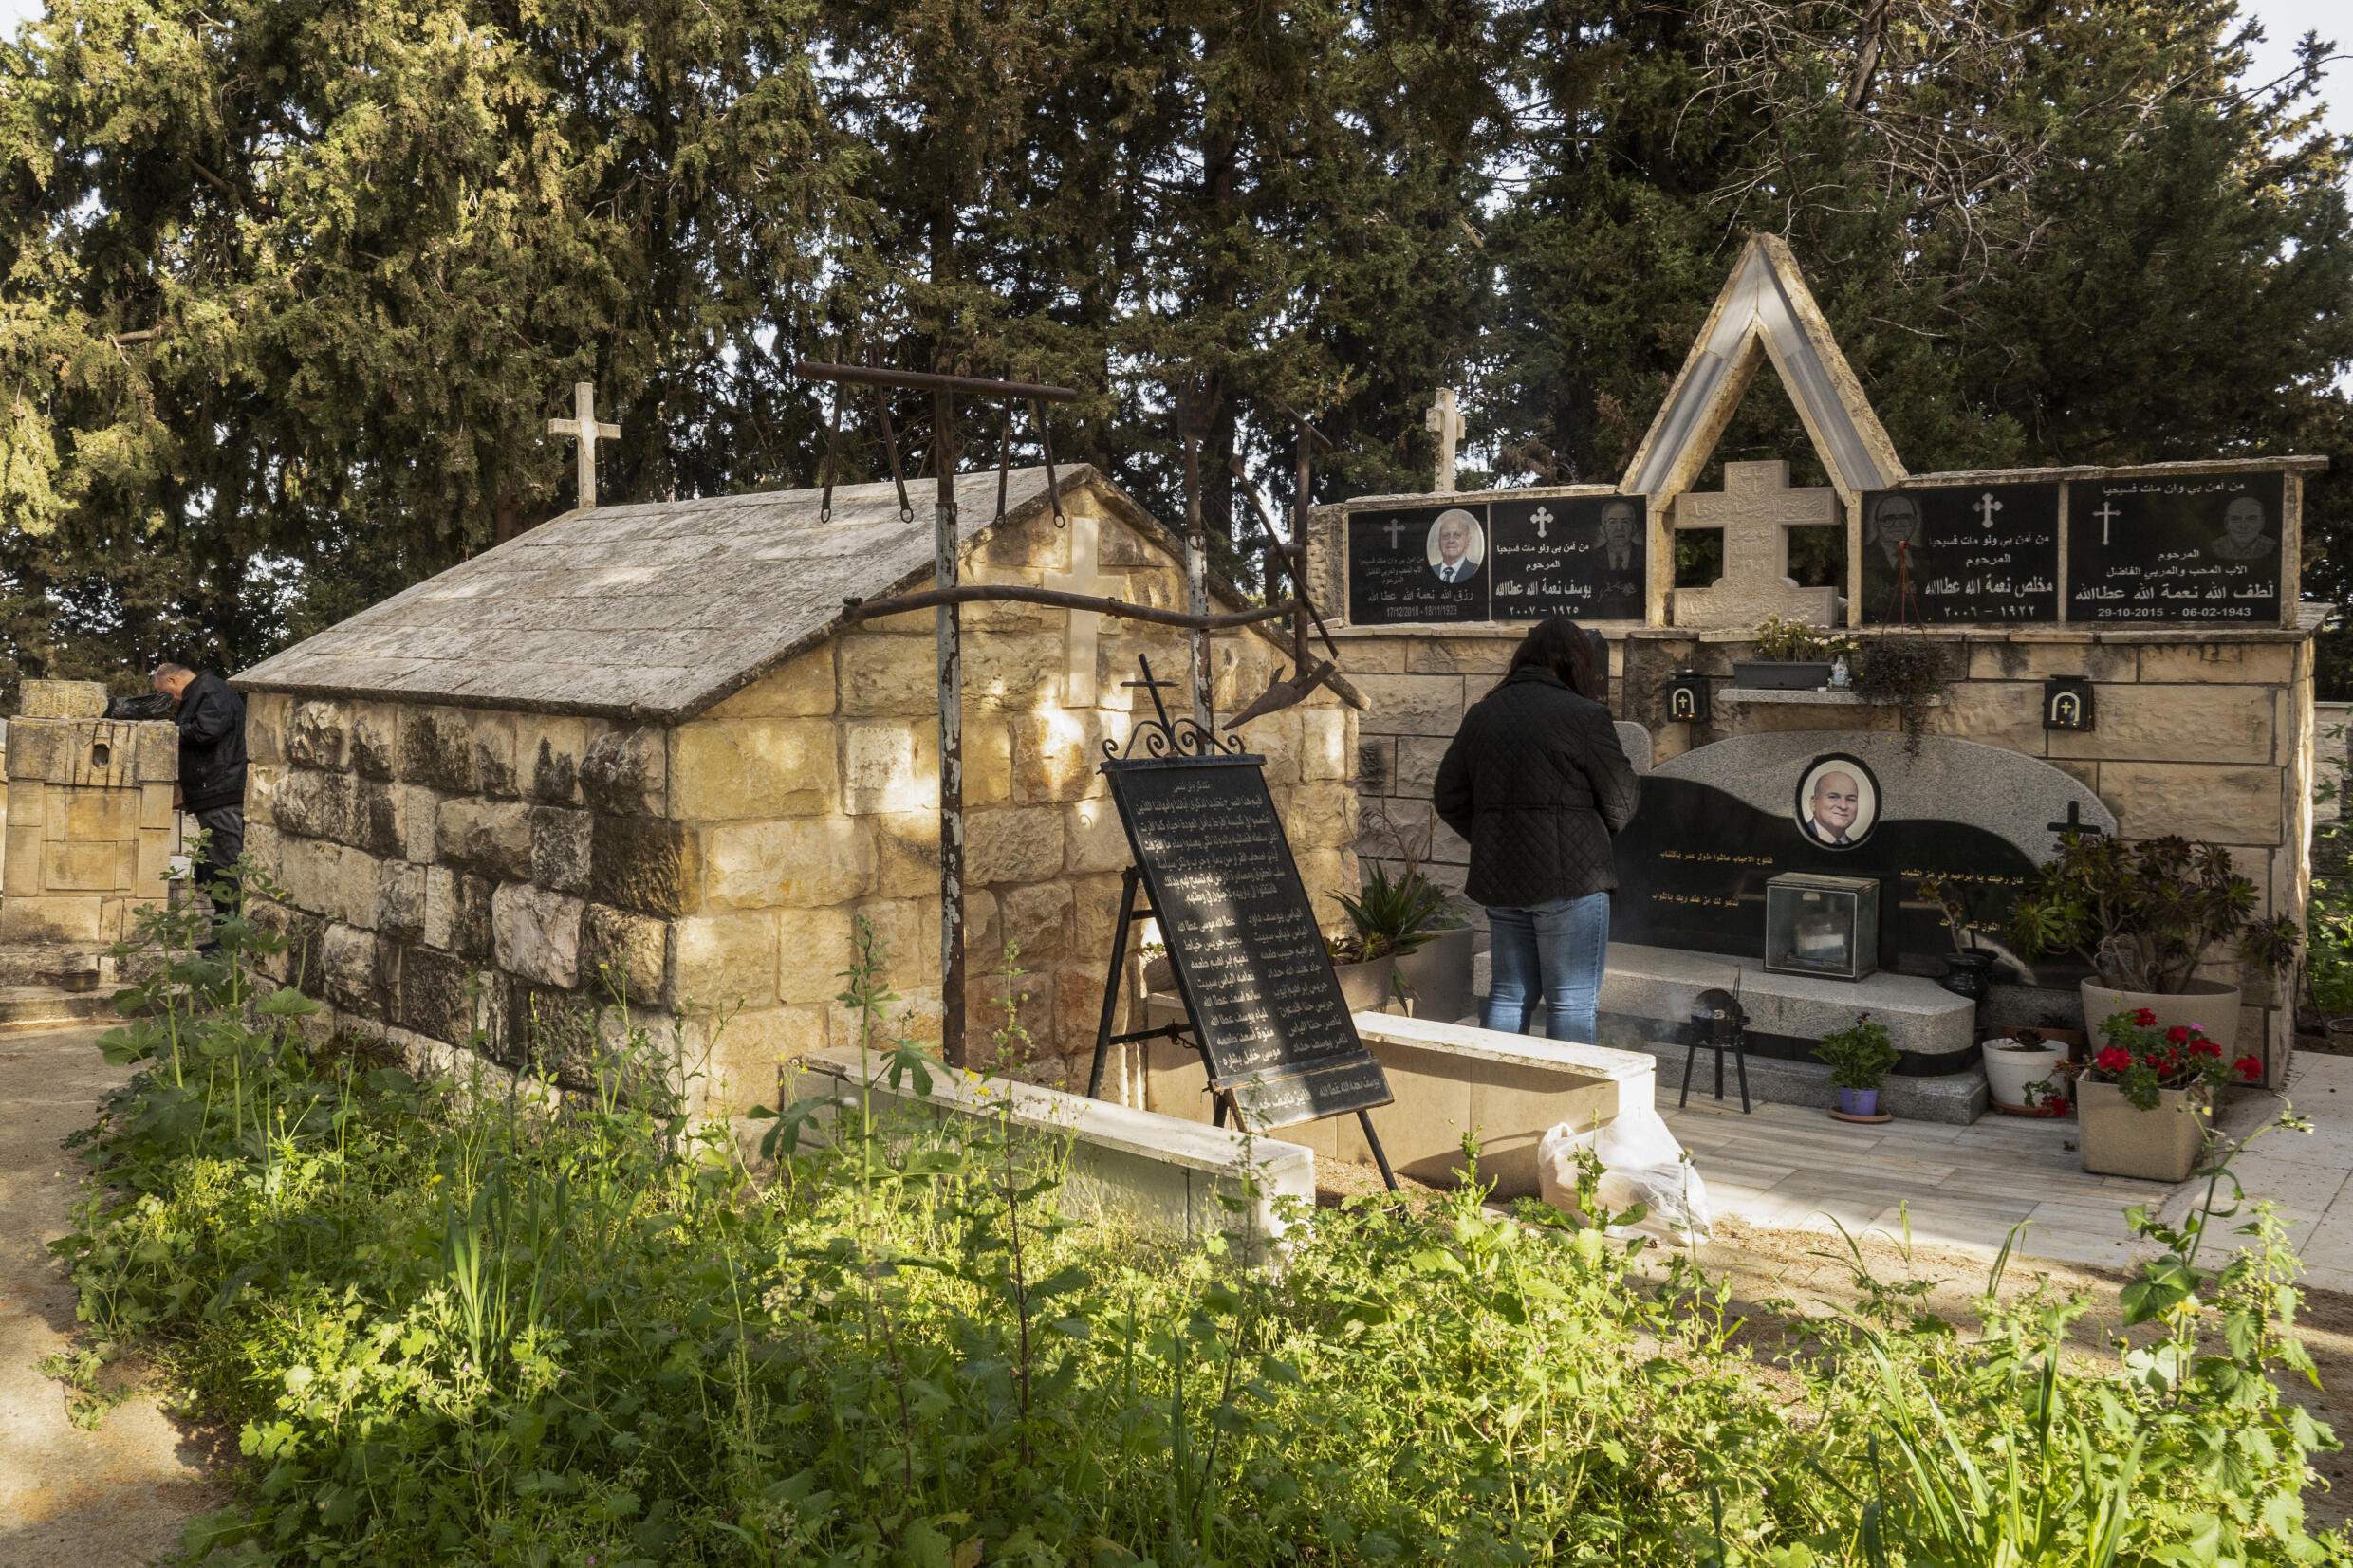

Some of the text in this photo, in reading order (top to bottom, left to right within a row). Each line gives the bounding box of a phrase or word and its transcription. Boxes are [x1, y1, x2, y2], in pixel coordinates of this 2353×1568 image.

[2103, 483, 2138, 496] فسيحيا
[2140, 484, 2161, 493] مات
[2228, 482, 2245, 492] من
[1928, 534, 1958, 548] فسيحيا
[1960, 535, 1979, 544] مات
[2035, 534, 2050, 544] من
[1496, 543, 1520, 555] فسيحيا
[1521, 544, 1536, 552] مات
[1578, 543, 1590, 553] من
[2157, 548, 2200, 561] المرحوم
[1525, 560, 1561, 573] المرحوم
[1965, 553, 2011, 568] المرحوم
[2105, 566, 2140, 578] الفاضل
[1526, 580, 1539, 596] الله
[1542, 577, 1562, 595] نعمة
[1564, 579, 1592, 599] يوسف
[1965, 577, 1981, 595] الله
[1985, 573, 2011, 593] نعمة
[2014, 575, 2053, 599] مخلص
[1402, 587, 1414, 600] الله
[1416, 587, 1435, 600] نعمة
[1440, 587, 1452, 600] الله
[1454, 589, 1473, 602] رزق
[2133, 582, 2155, 600] الله
[2161, 583, 2198, 599] نعمة
[2205, 581, 2227, 599] الله
[2097, 607, 2164, 618] 29-10-2015
[2182, 607, 2252, 617] 06-02-1943
[1263, 913, 1284, 923] يوسف
[1183, 938, 1202, 952] خياط
[1232, 951, 1249, 968] نعيم
[1235, 1012, 1256, 1024] يوسف
[1311, 1040, 1333, 1050] يوسف
[1244, 1048, 1260, 1064] خليل
